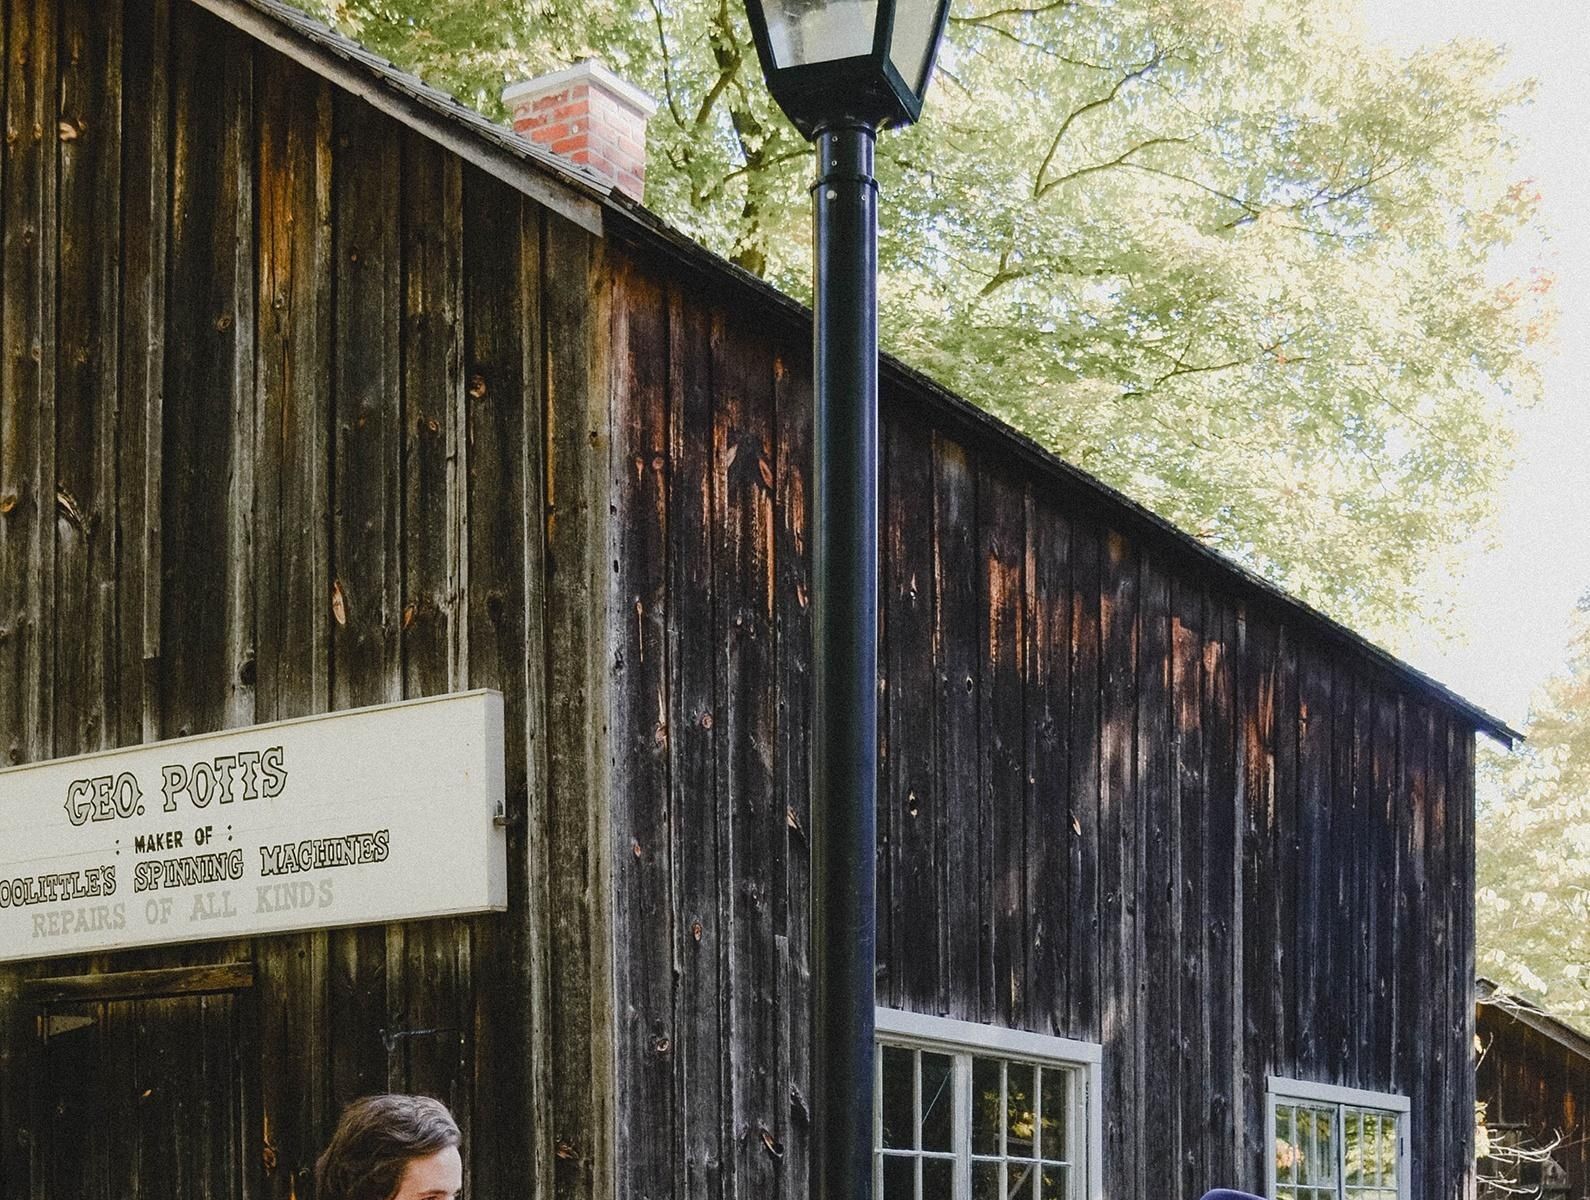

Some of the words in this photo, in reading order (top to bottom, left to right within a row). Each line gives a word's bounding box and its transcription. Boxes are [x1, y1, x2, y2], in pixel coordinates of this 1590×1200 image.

[63, 771, 145, 827] GEO.
[161, 745, 289, 812] POTTS
[134, 830, 184, 854] MAKER
[194, 826, 214, 846] OF
[134, 849, 245, 894] SPINNING
[259, 829, 390, 876] MACHINES
[31, 902, 127, 939] REPAIRS
[145, 896, 174, 926] OF
[189, 889, 237, 922] ALL
[255, 877, 335, 914] KINDS
